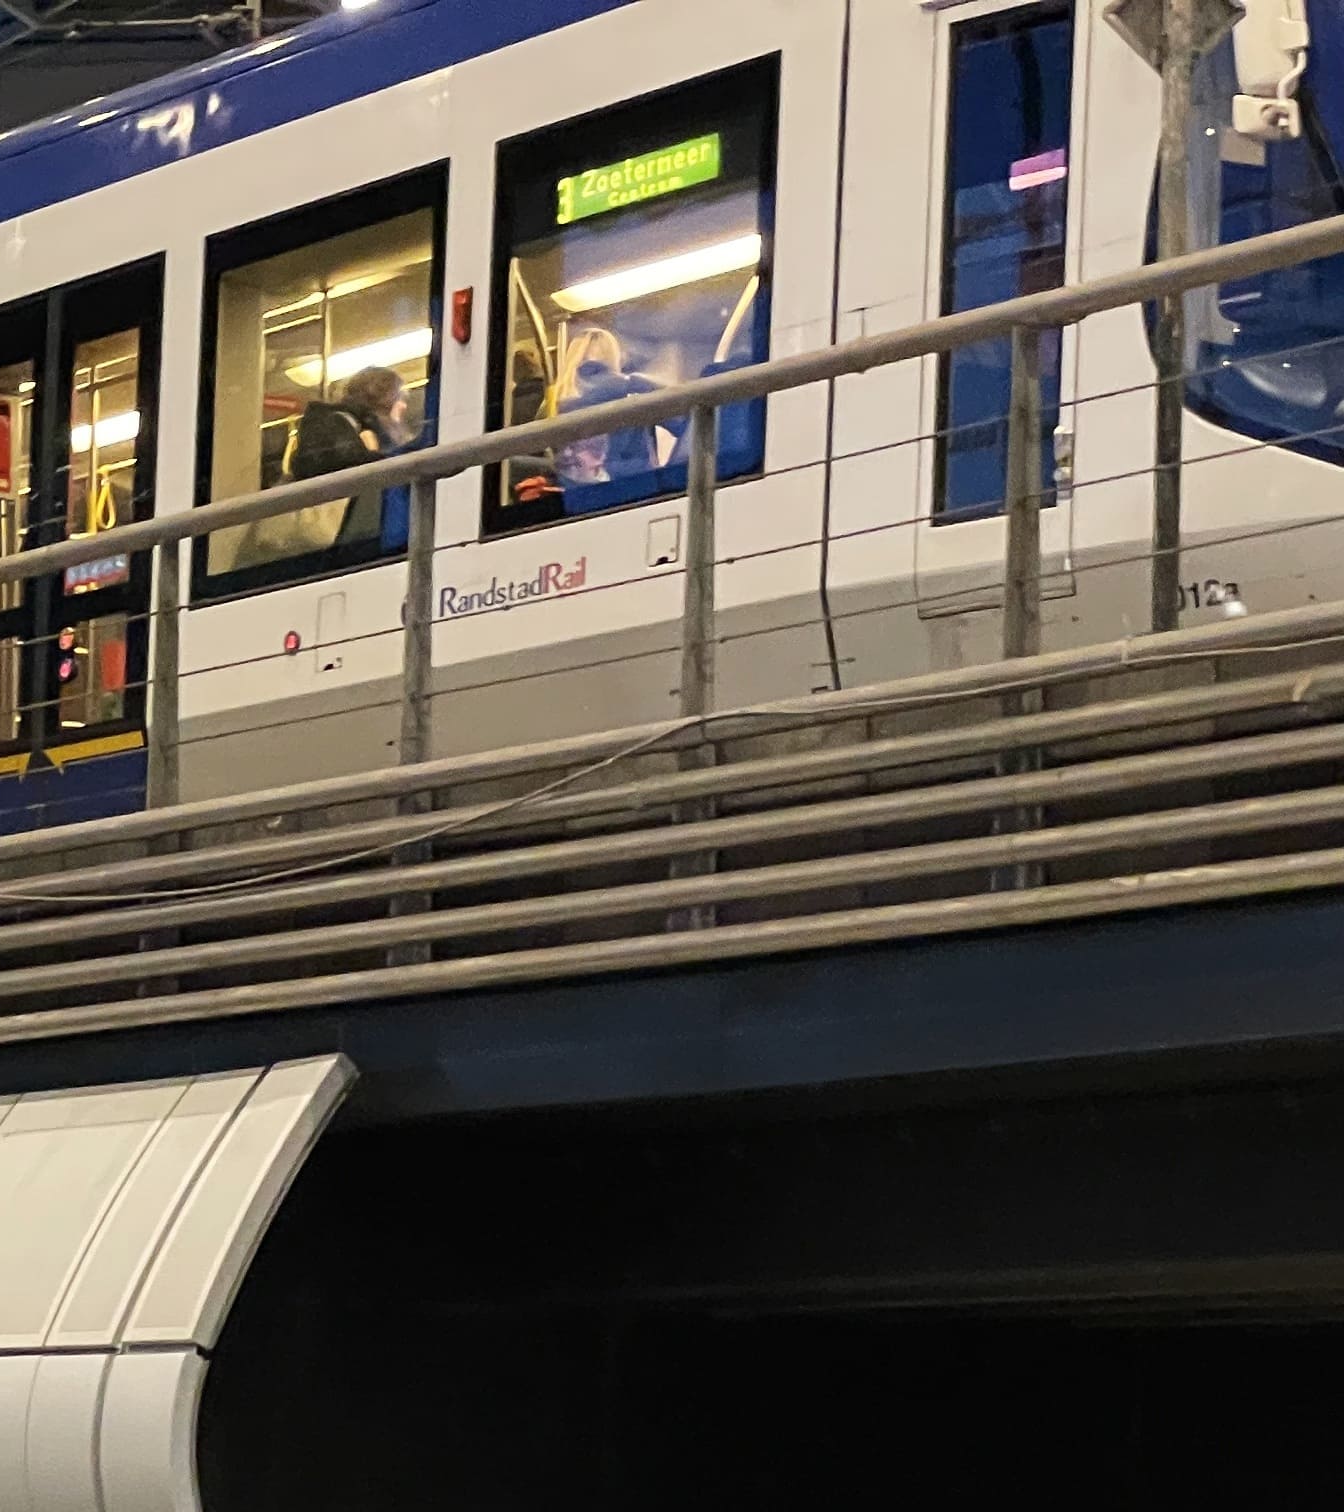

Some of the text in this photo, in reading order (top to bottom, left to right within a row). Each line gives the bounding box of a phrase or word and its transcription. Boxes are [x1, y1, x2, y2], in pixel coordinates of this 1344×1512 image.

[557, 142, 712, 225] 3 Zoetermeer
[439, 556, 587, 617] RandstadRail
